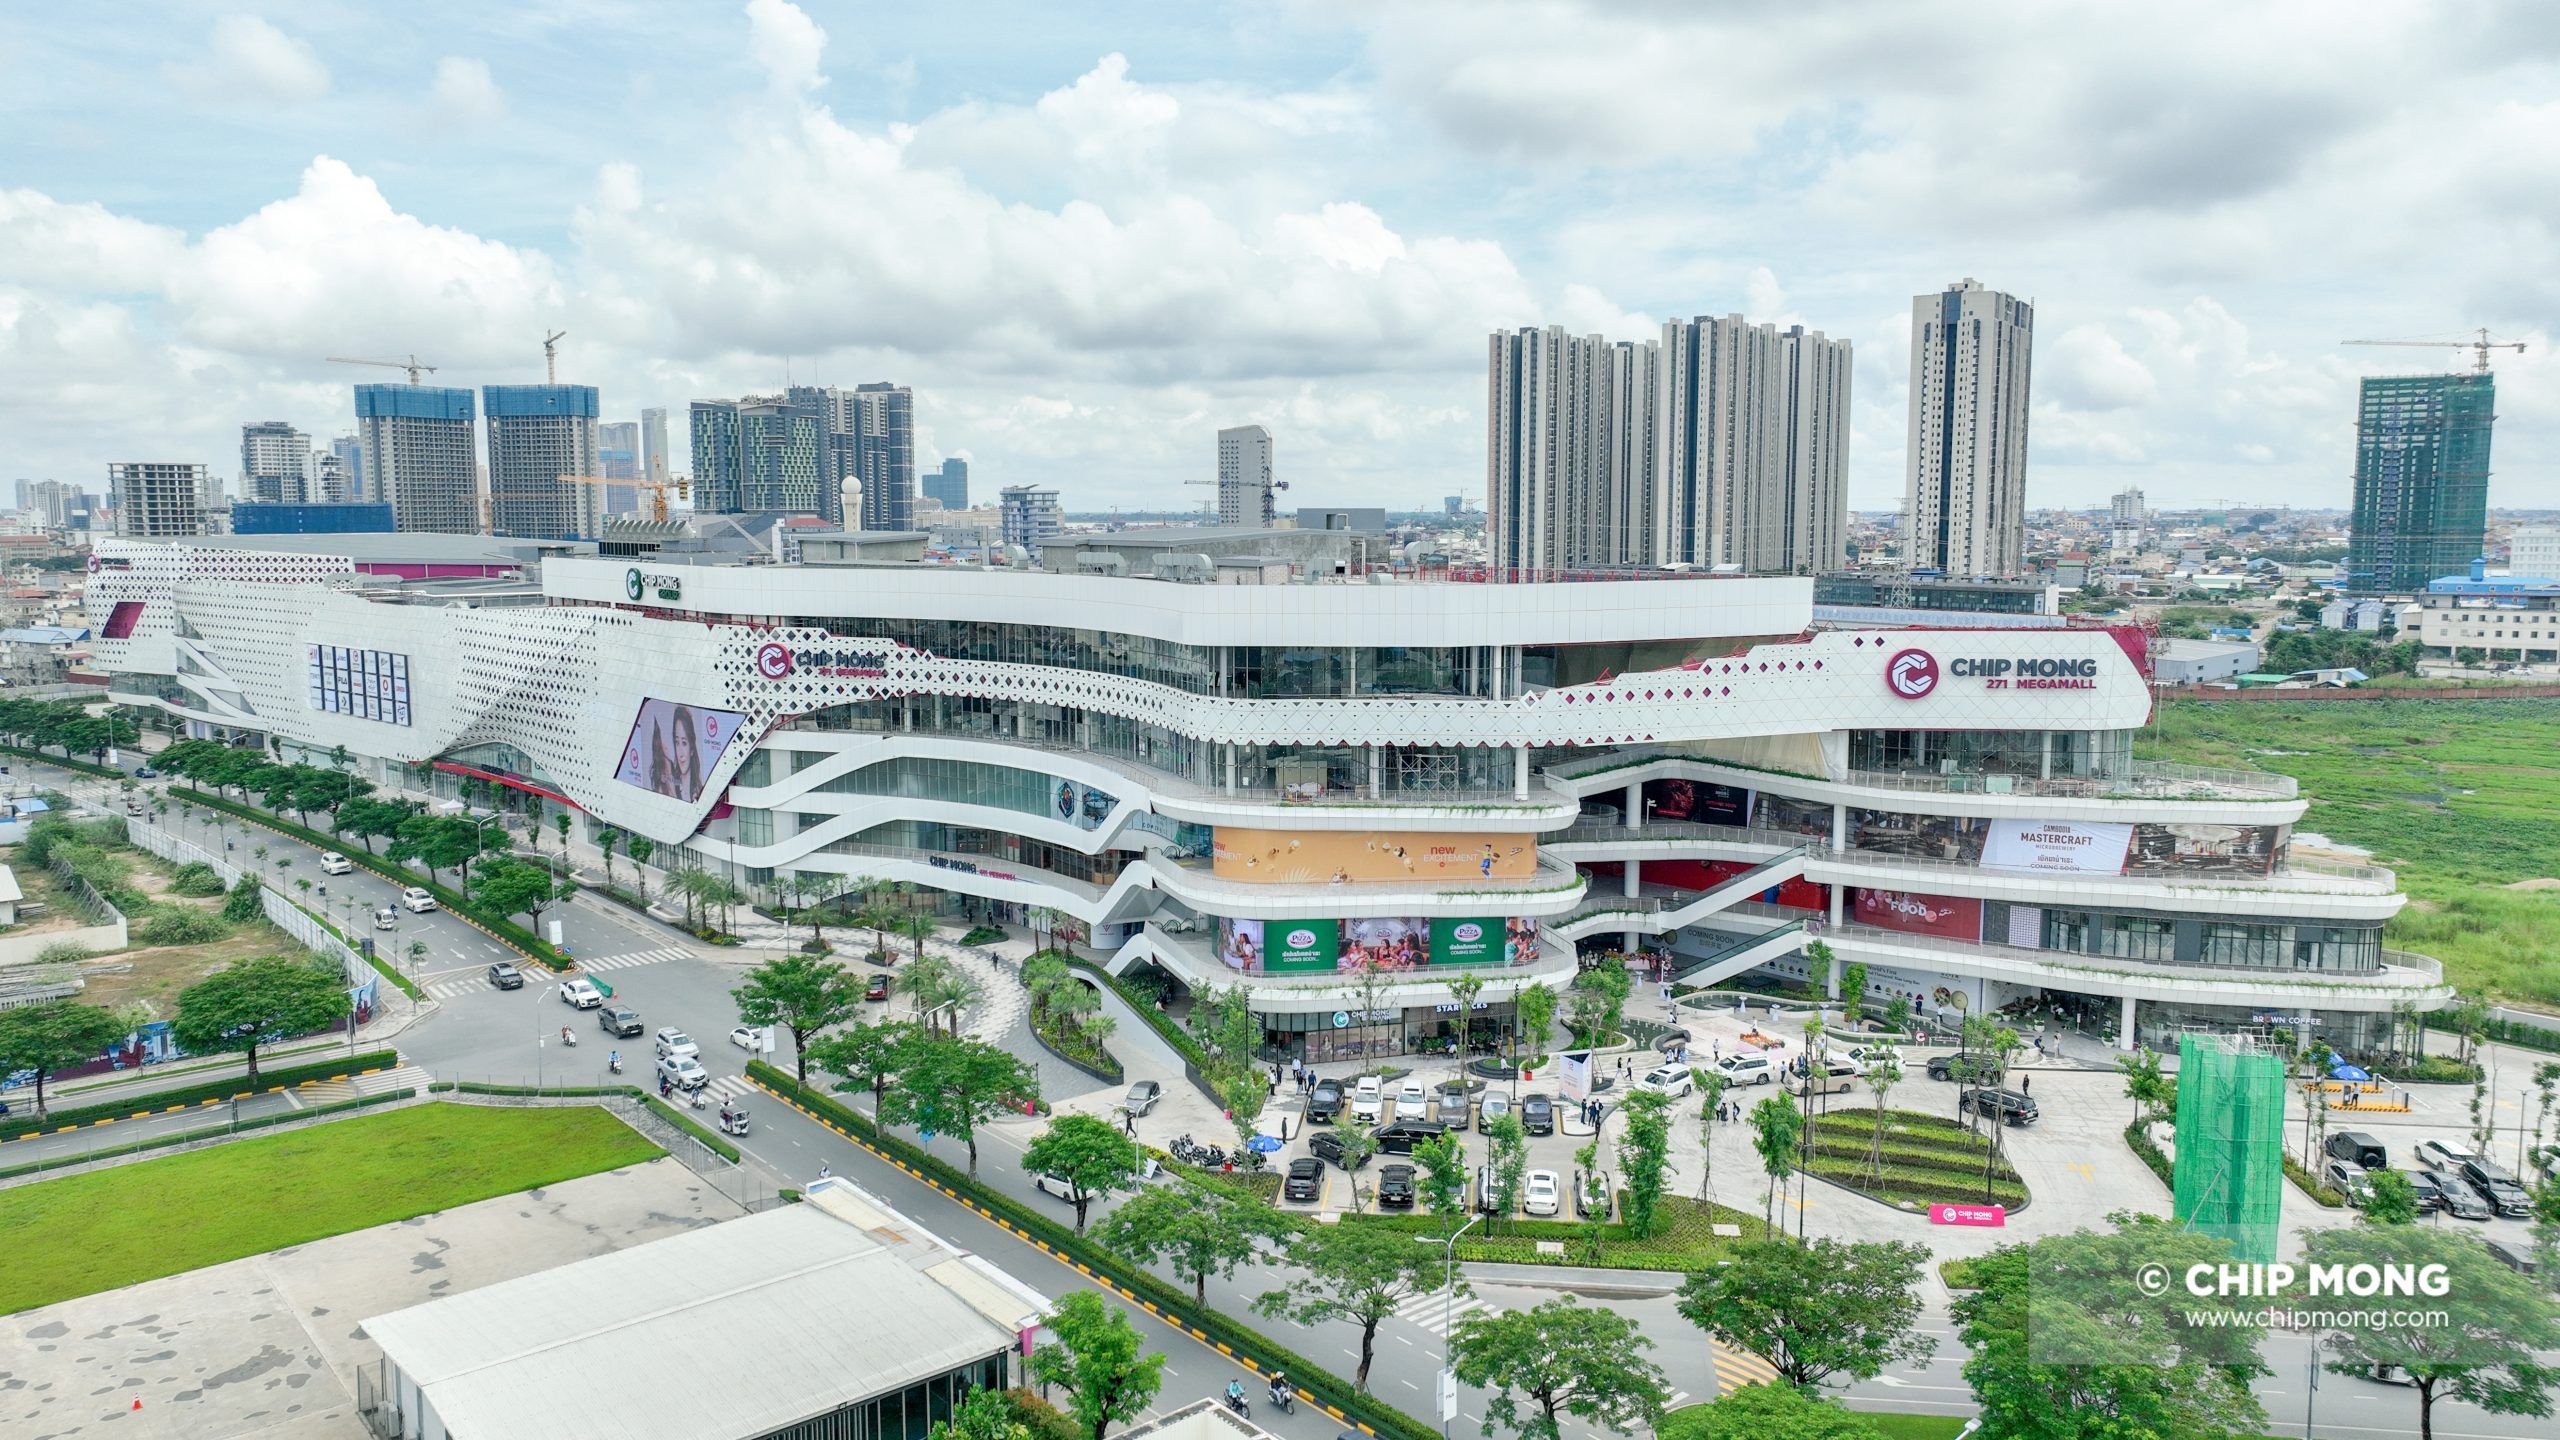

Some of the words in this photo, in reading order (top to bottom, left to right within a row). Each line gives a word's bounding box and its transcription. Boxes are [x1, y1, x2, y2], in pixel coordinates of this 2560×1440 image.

[657, 575, 680, 589] MONG
[795, 652, 832, 667] CHIP
[835, 654, 885, 669] MONG
[1950, 658, 2012, 677] CHIP
[2016, 658, 2097, 677] MONG
[1986, 679, 2008, 689] 271
[2016, 679, 2097, 689] MEGAMALL
[2020, 832, 2093, 845] MASTERCRAFT
[1430, 846, 1456, 855] new
[1423, 854, 1478, 862] EXCITEMENT
[1890, 901, 1927, 916] FOOD
[1687, 928, 1714, 941] COMING
[1715, 934, 1735, 945] SOON
[1436, 1003, 1488, 1013] STARCKS
[2252, 1015, 2286, 1024] BROWN
[2288, 1017, 2322, 1025] COFFEE
